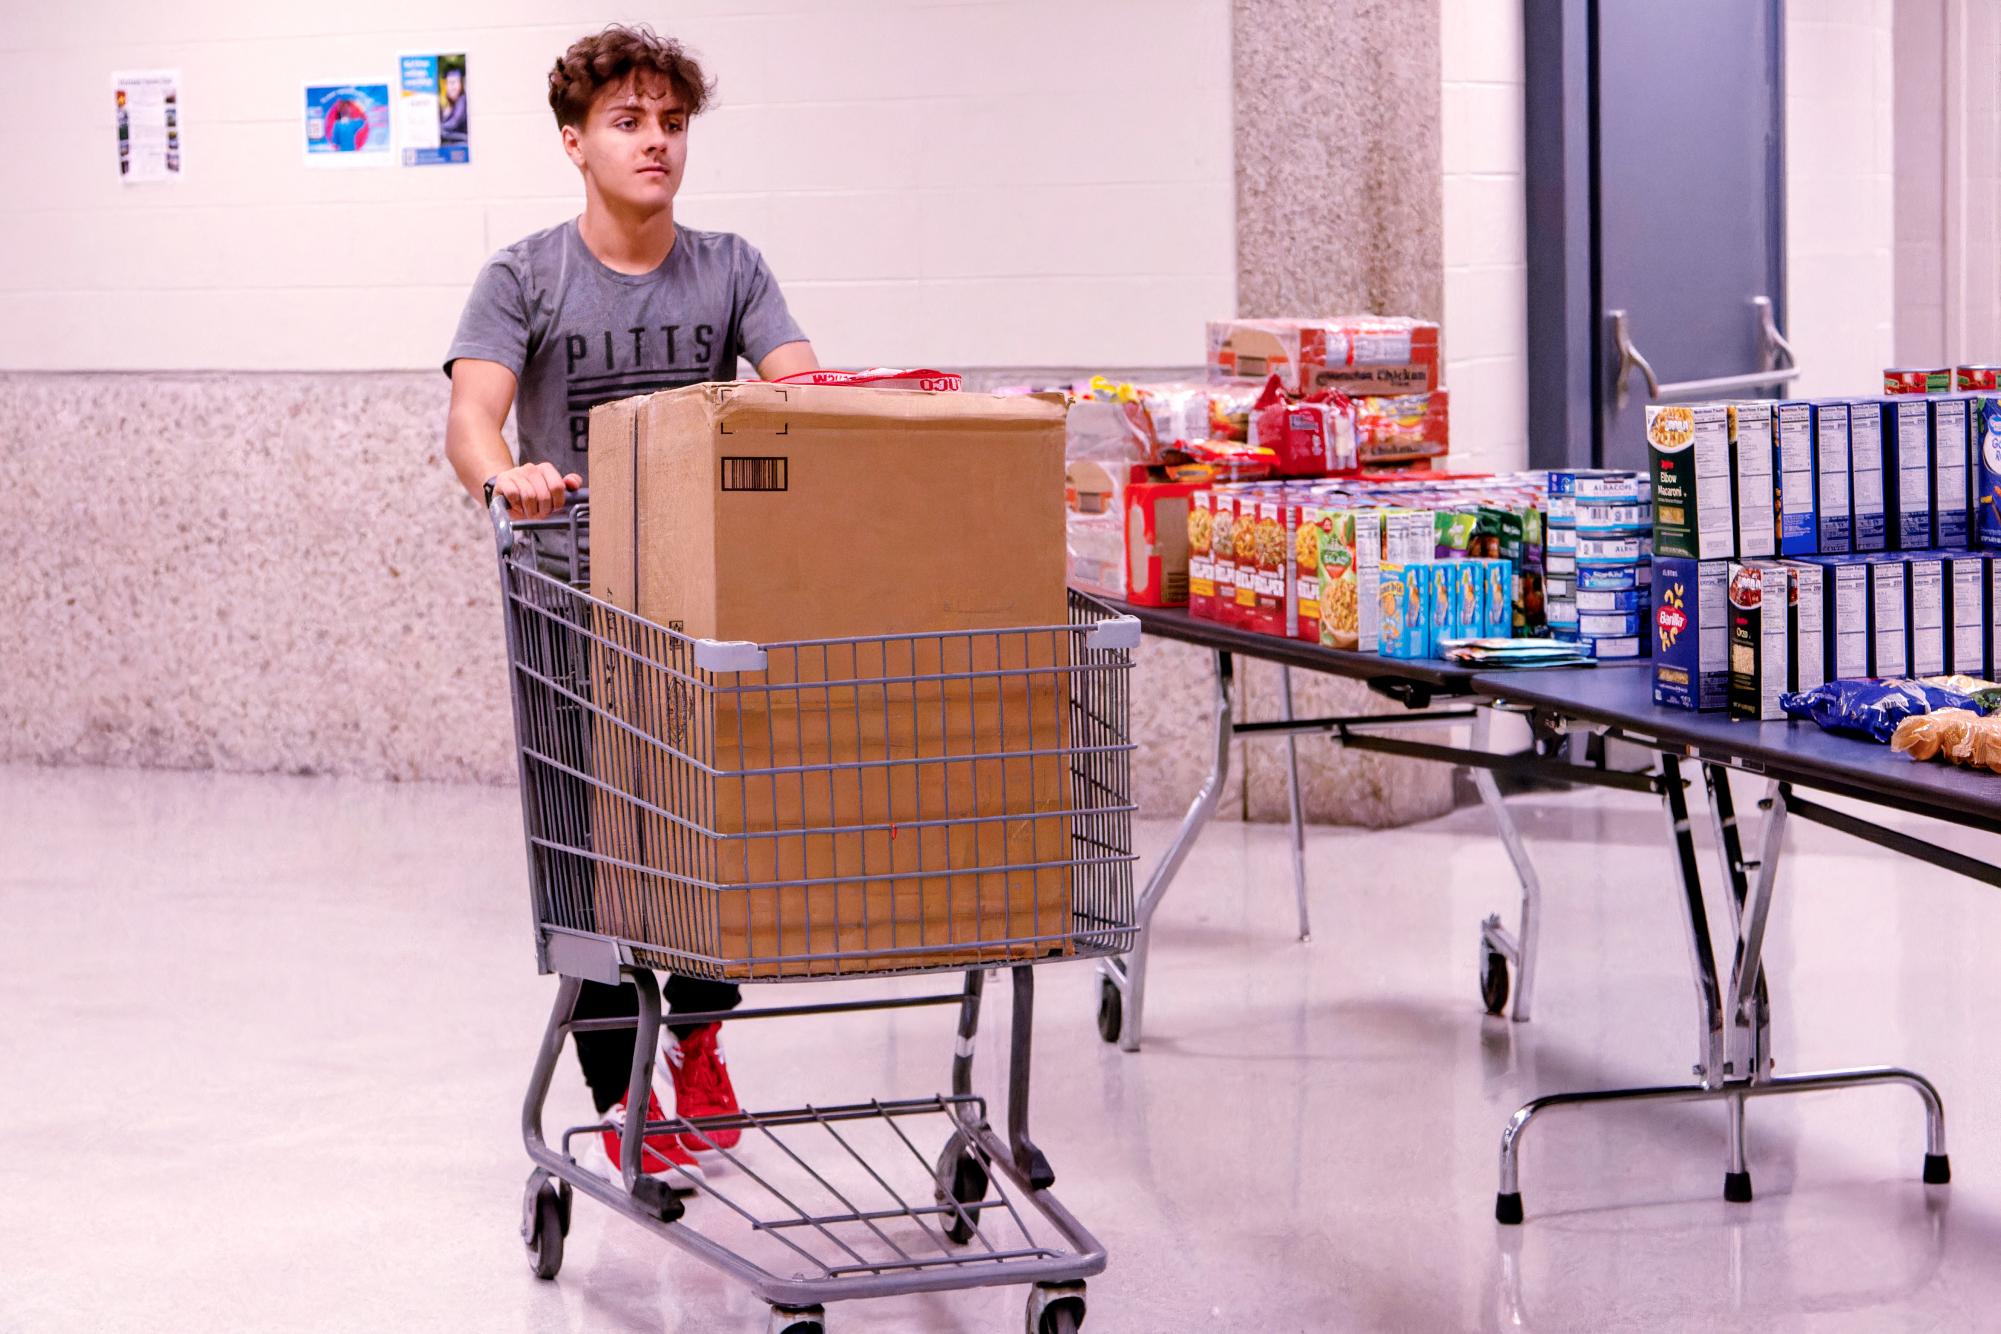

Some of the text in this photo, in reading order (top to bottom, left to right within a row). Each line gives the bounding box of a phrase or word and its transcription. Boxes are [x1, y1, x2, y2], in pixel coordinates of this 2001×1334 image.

[566, 324, 714, 374] PITTS
[1660, 472, 1677, 483] Elbow
[1658, 486, 1682, 496] Macaroni
[1660, 611, 1685, 628] Barilla
